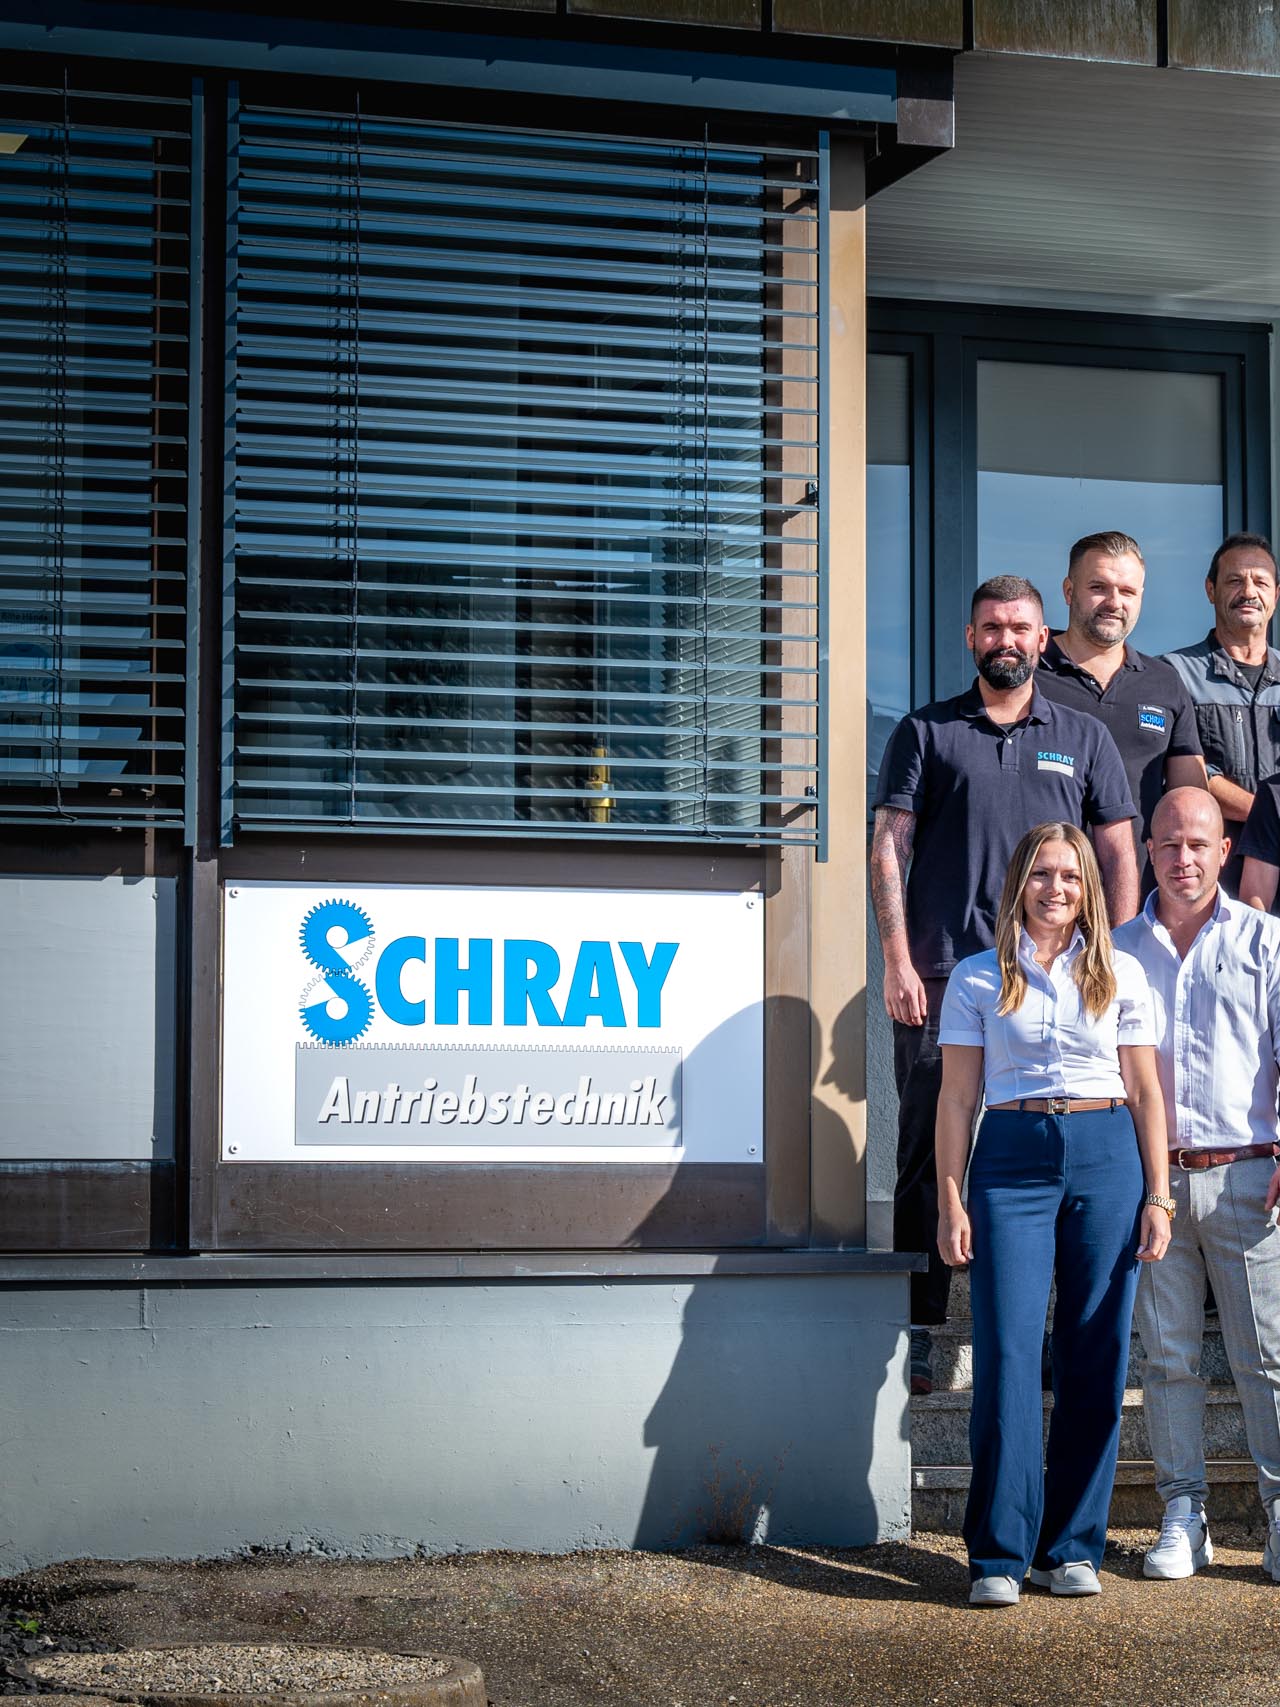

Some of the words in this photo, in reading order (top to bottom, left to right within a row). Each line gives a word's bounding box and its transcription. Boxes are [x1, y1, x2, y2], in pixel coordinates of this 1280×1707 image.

[1141, 714, 1165, 727] SCHRAY
[1037, 752, 1074, 765] SCHRAY
[298, 898, 681, 1047] SCHRAY
[316, 1075, 670, 1126] Antriebstechnik
